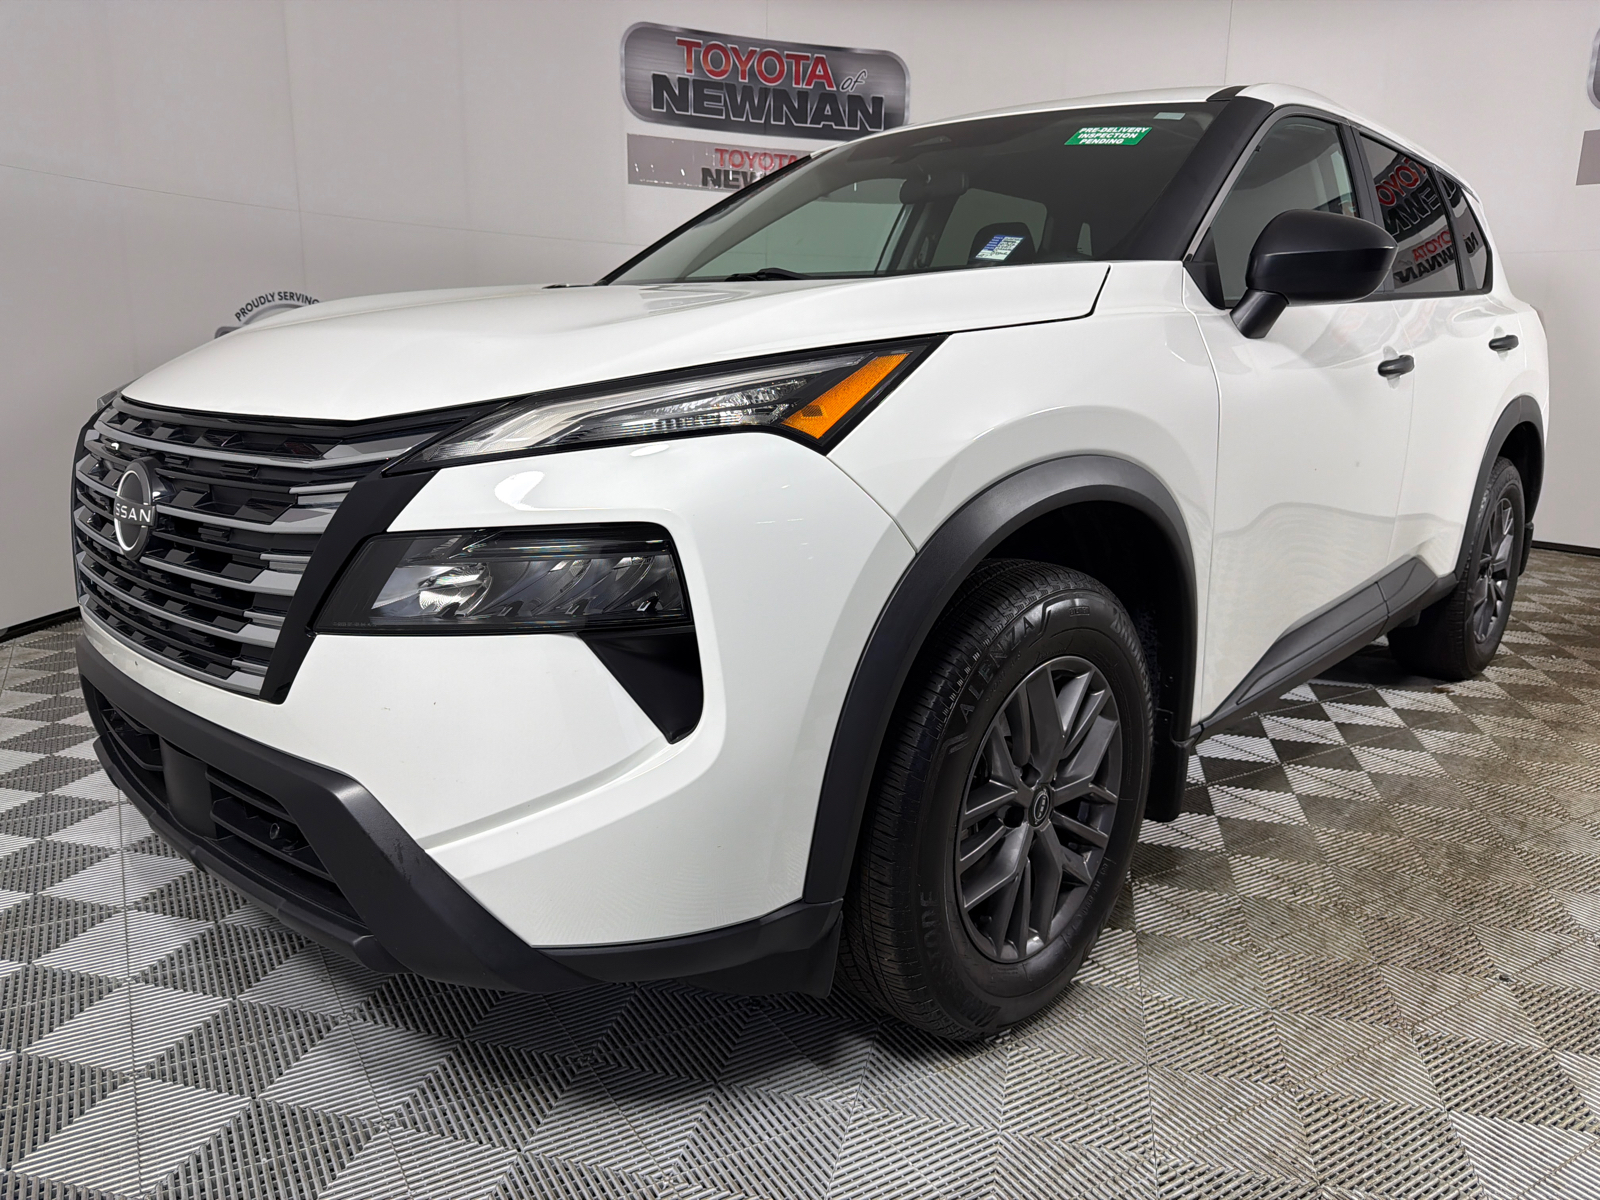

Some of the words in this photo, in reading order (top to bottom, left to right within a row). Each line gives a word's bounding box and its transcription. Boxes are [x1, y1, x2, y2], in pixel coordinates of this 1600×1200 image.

[675, 36, 837, 91] TOYOTA
[840, 70, 867, 92] of
[651, 72, 885, 132] NEWNAN
[234, 292, 276, 322] PROUDLY
[115, 503, 151, 523] SSAN
[957, 614, 1034, 725] ALENZA
